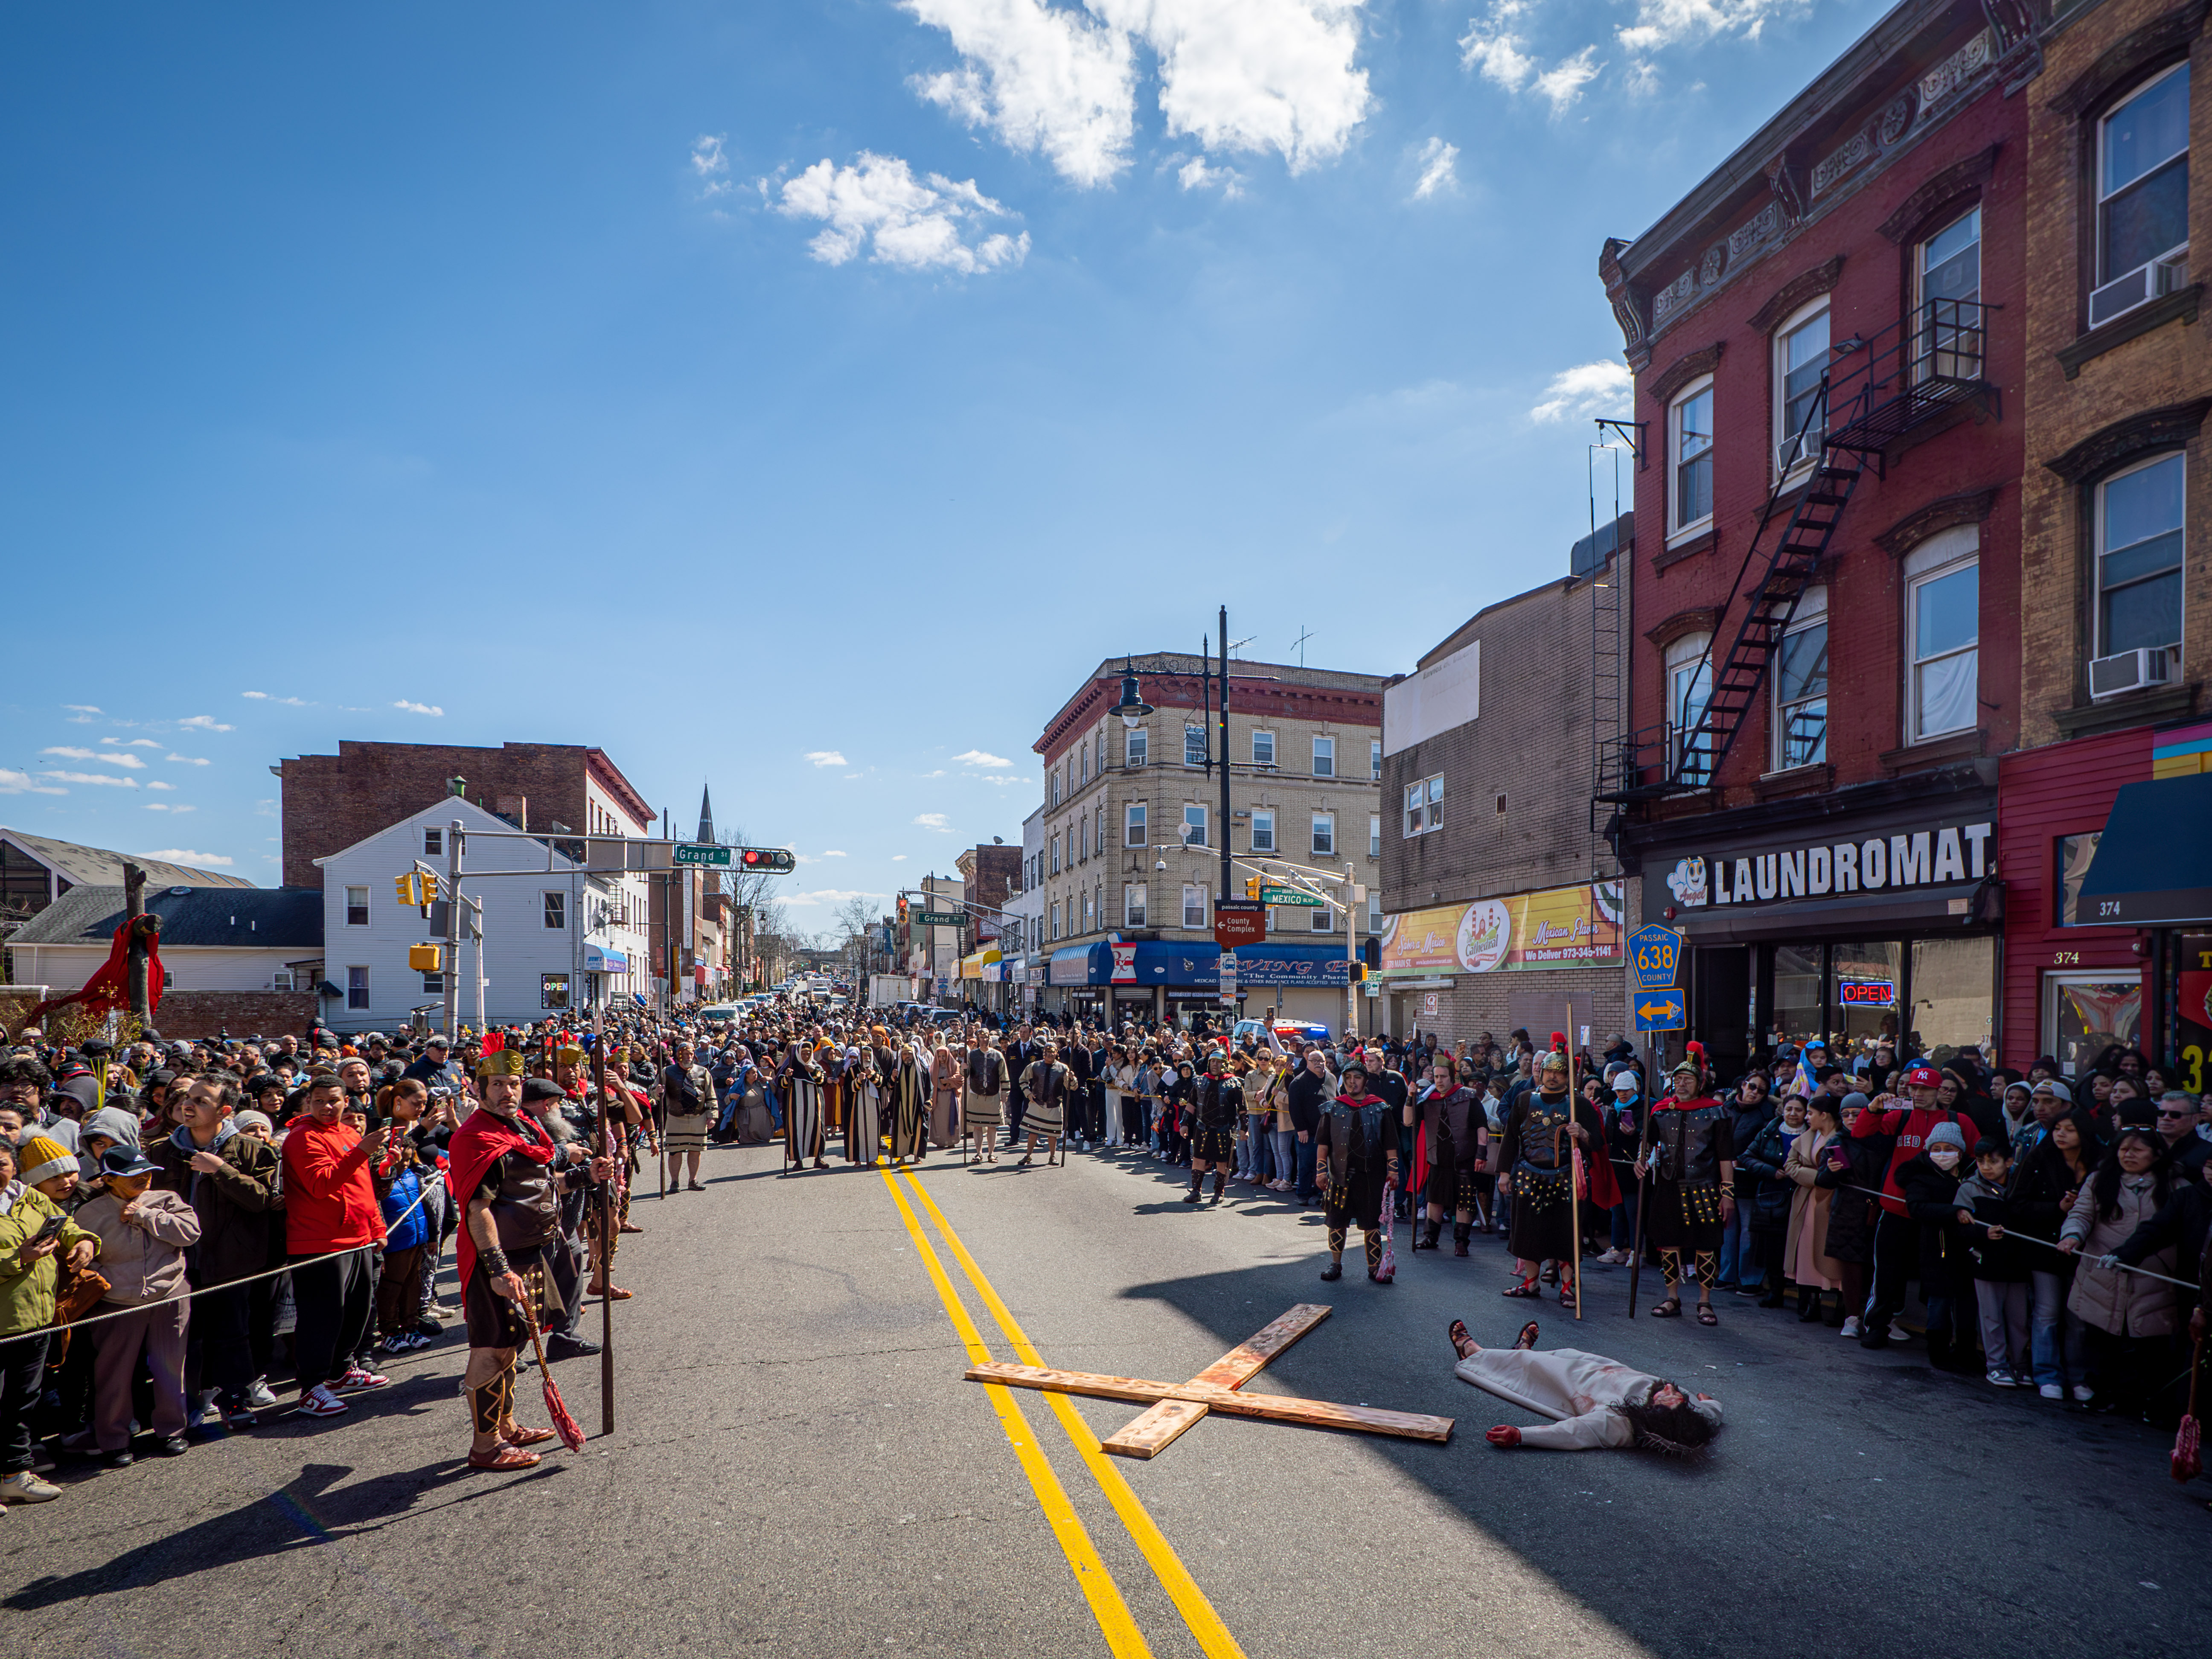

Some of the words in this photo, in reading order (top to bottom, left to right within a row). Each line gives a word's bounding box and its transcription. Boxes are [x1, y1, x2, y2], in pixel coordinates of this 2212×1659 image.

[680, 849, 714, 861] Grand
[1715, 822, 1991, 904] LAUNDROMAT
[1272, 895, 1301, 904] MEXICO
[1679, 887, 1706, 905] Angel
[2100, 901, 2120, 916] 374
[1227, 917, 1249, 926] County
[1533, 920, 1569, 945] Mexican
[1570, 917, 1599, 941] Flavor
[1397, 934, 1415, 956] Sabor
[1421, 931, 1445, 954] México
[1639, 934, 1668, 942] PASSAIC
[1466, 934, 1498, 957] Cathedral
[1525, 951, 1536, 960] We
[1538, 949, 1561, 960] Deliver
[1563, 945, 1611, 958] 973-345-1141
[1638, 945, 1673, 970] 638
[2054, 952, 2079, 964] 374
[1642, 973, 1671, 981] COUNTY
[544, 983, 568, 991] OPEN
[1845, 986, 1891, 1000] OPEN
[1427, 996, 1435, 1006] Q
[1897, 1135, 1920, 1147] RED
